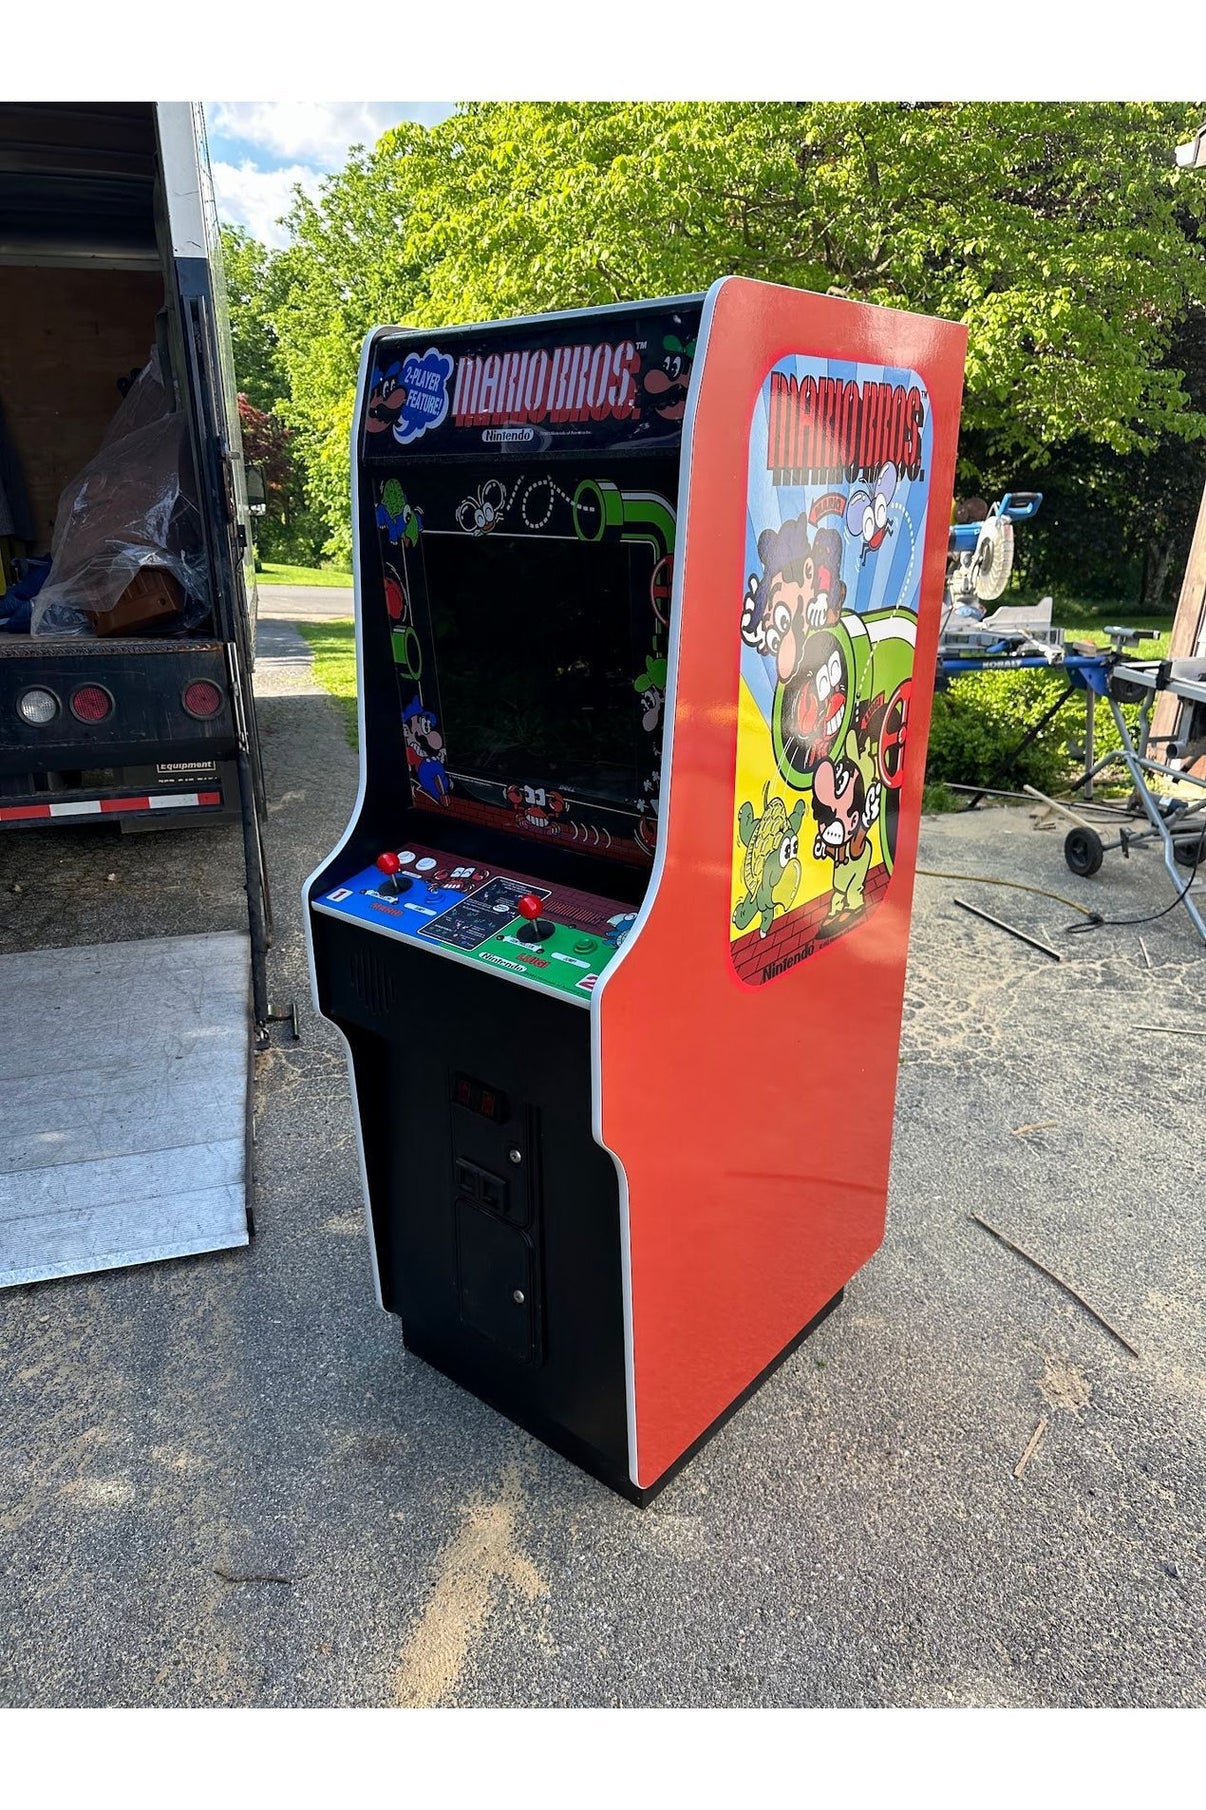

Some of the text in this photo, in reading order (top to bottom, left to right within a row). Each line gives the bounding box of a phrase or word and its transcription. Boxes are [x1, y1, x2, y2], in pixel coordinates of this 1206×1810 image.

[404, 366, 441, 392] 2-PLAYER
[452, 350, 550, 427] MARIO
[406, 389, 443, 416] FEATURE!
[485, 428, 531, 441] Nintendo
[767, 371, 861, 486] MARIO
[482, 952, 524, 972] Nintendo
[762, 940, 815, 984] Nintendo
